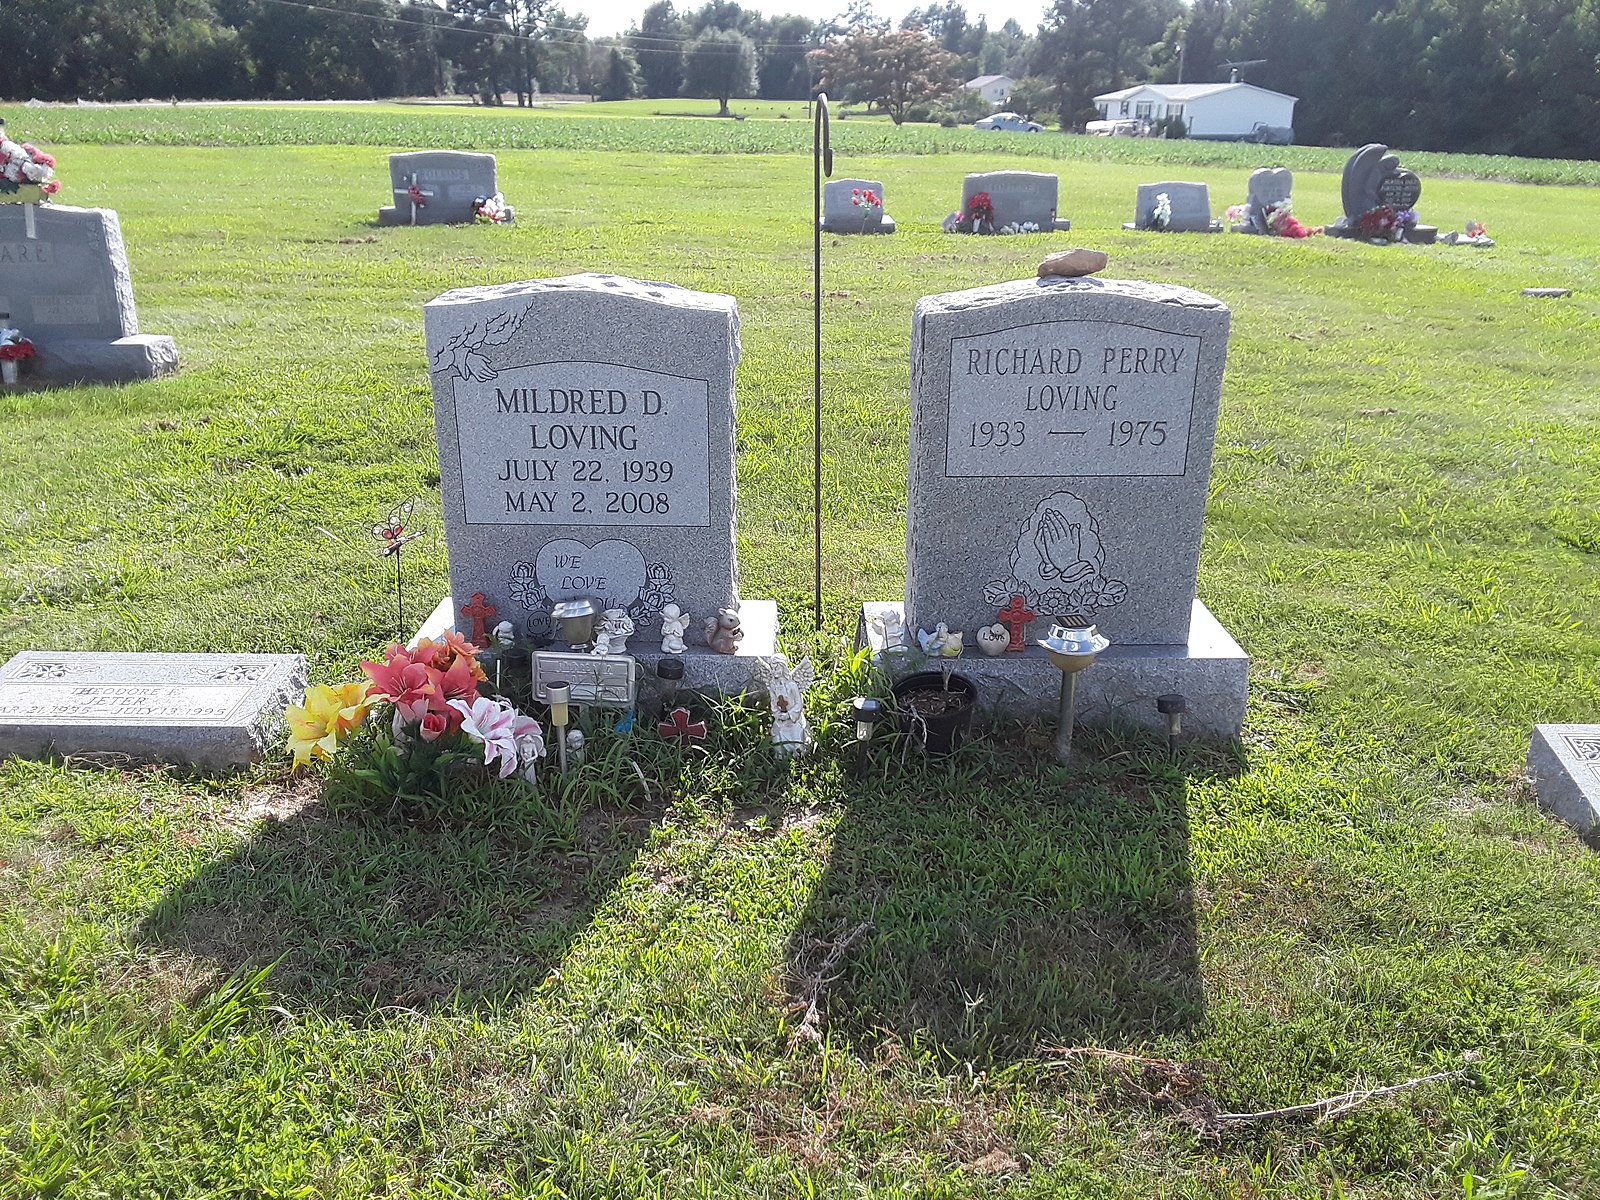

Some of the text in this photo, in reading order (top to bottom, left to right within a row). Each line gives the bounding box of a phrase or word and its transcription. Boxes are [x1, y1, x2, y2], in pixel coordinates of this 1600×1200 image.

[966, 347, 1185, 376] RICHARD PERRY
[495, 387, 668, 416] MILDRED D.
[1024, 384, 1118, 411] LOVING
[530, 424, 638, 451] LOVING
[969, 420, 1026, 448] 1933
[1108, 420, 1168, 447] 1975
[498, 459, 673, 483] JULY 22, 1939
[505, 491, 670, 514] MAY 2, 2008
[555, 554, 581, 569] WE
[561, 576, 607, 590] LOVE
[528, 616, 549, 628] LOVE
[70, 687, 161, 696] THEODORE
[80, 696, 147, 706] JETER
[110, 706, 160, 715] JULY
[185, 707, 227, 716] 1995
